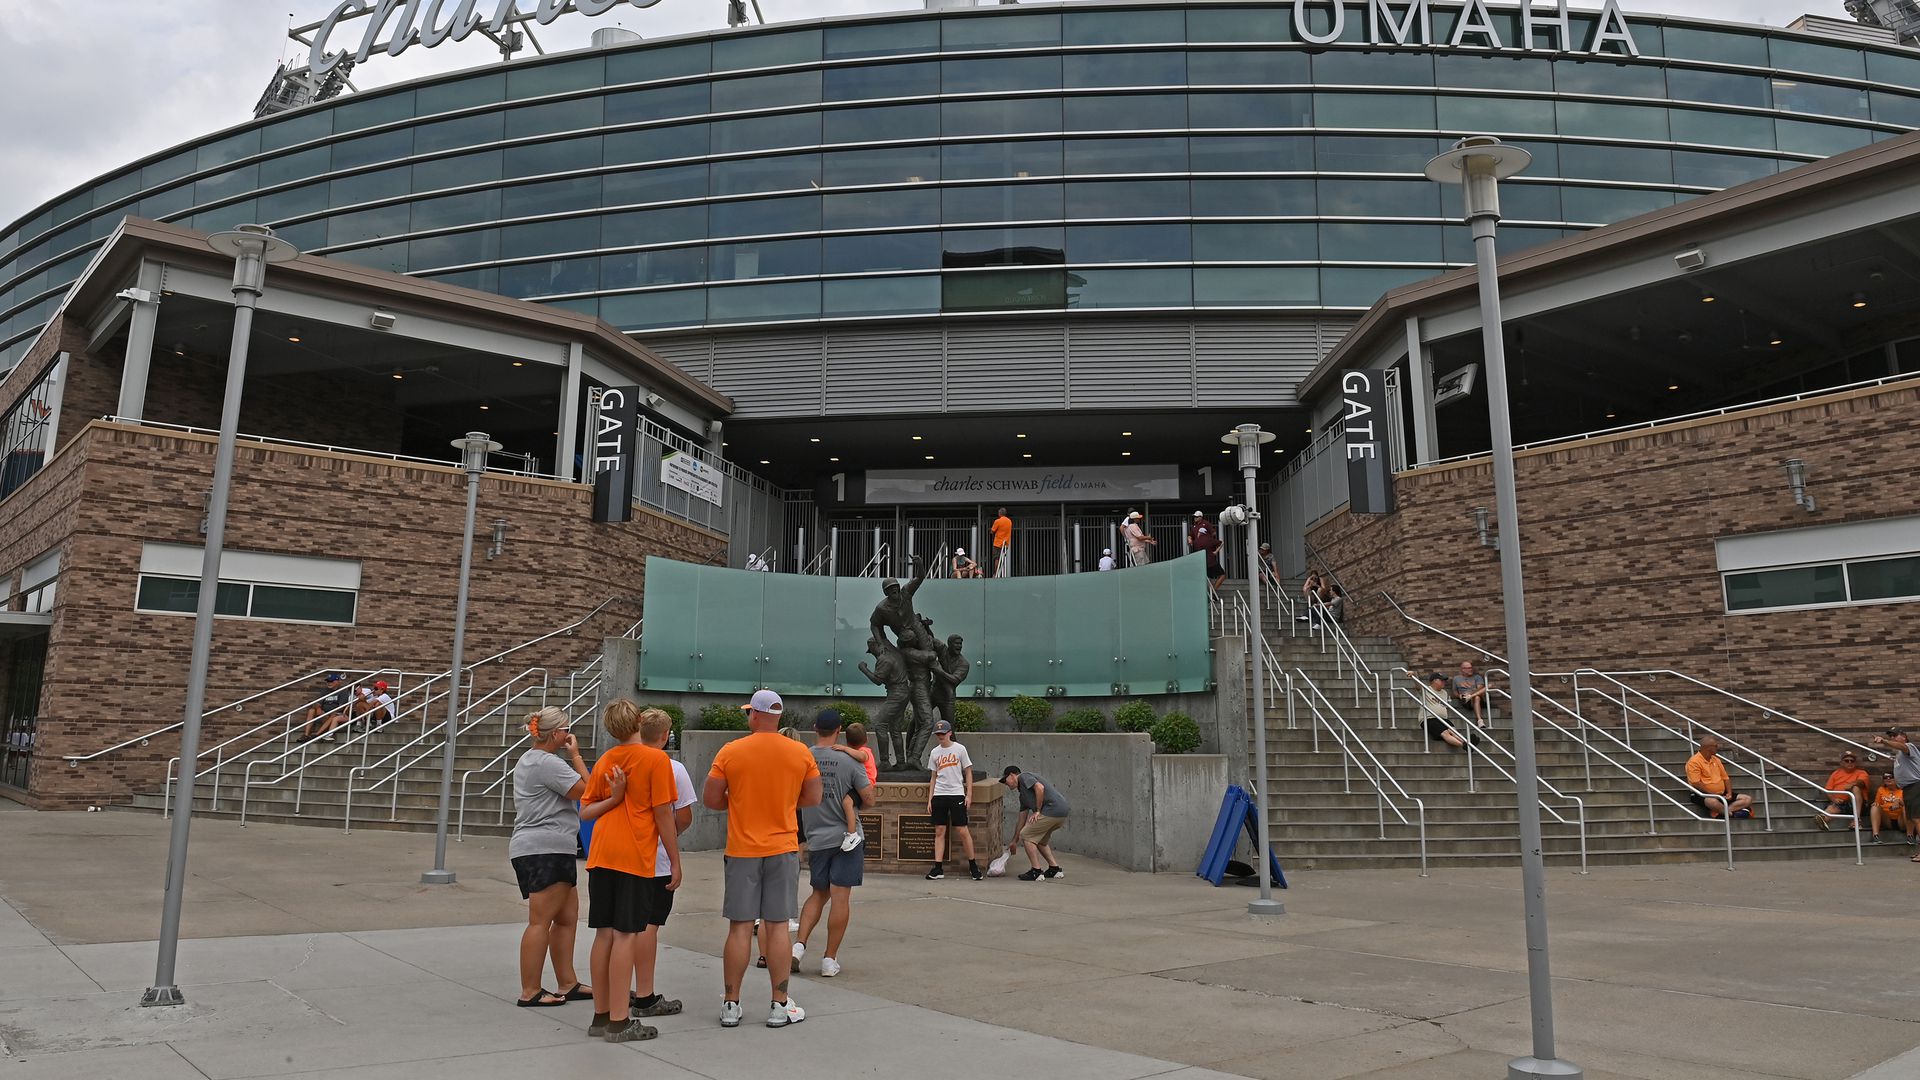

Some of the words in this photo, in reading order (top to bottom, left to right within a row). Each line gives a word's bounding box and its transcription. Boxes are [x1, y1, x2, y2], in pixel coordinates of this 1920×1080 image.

[1294, 0, 1640, 57] OMAHA
[1343, 371, 1375, 459] GATE
[595, 389, 625, 472] GATE
[832, 472, 845, 501] 1
[933, 476, 983, 491] charles
[986, 480, 1039, 491] SCHWAB
[1036, 474, 1074, 494] field
[1074, 481, 1107, 489] OMAHA
[1197, 466, 1213, 496] 1
[890, 786, 909, 797] TO
